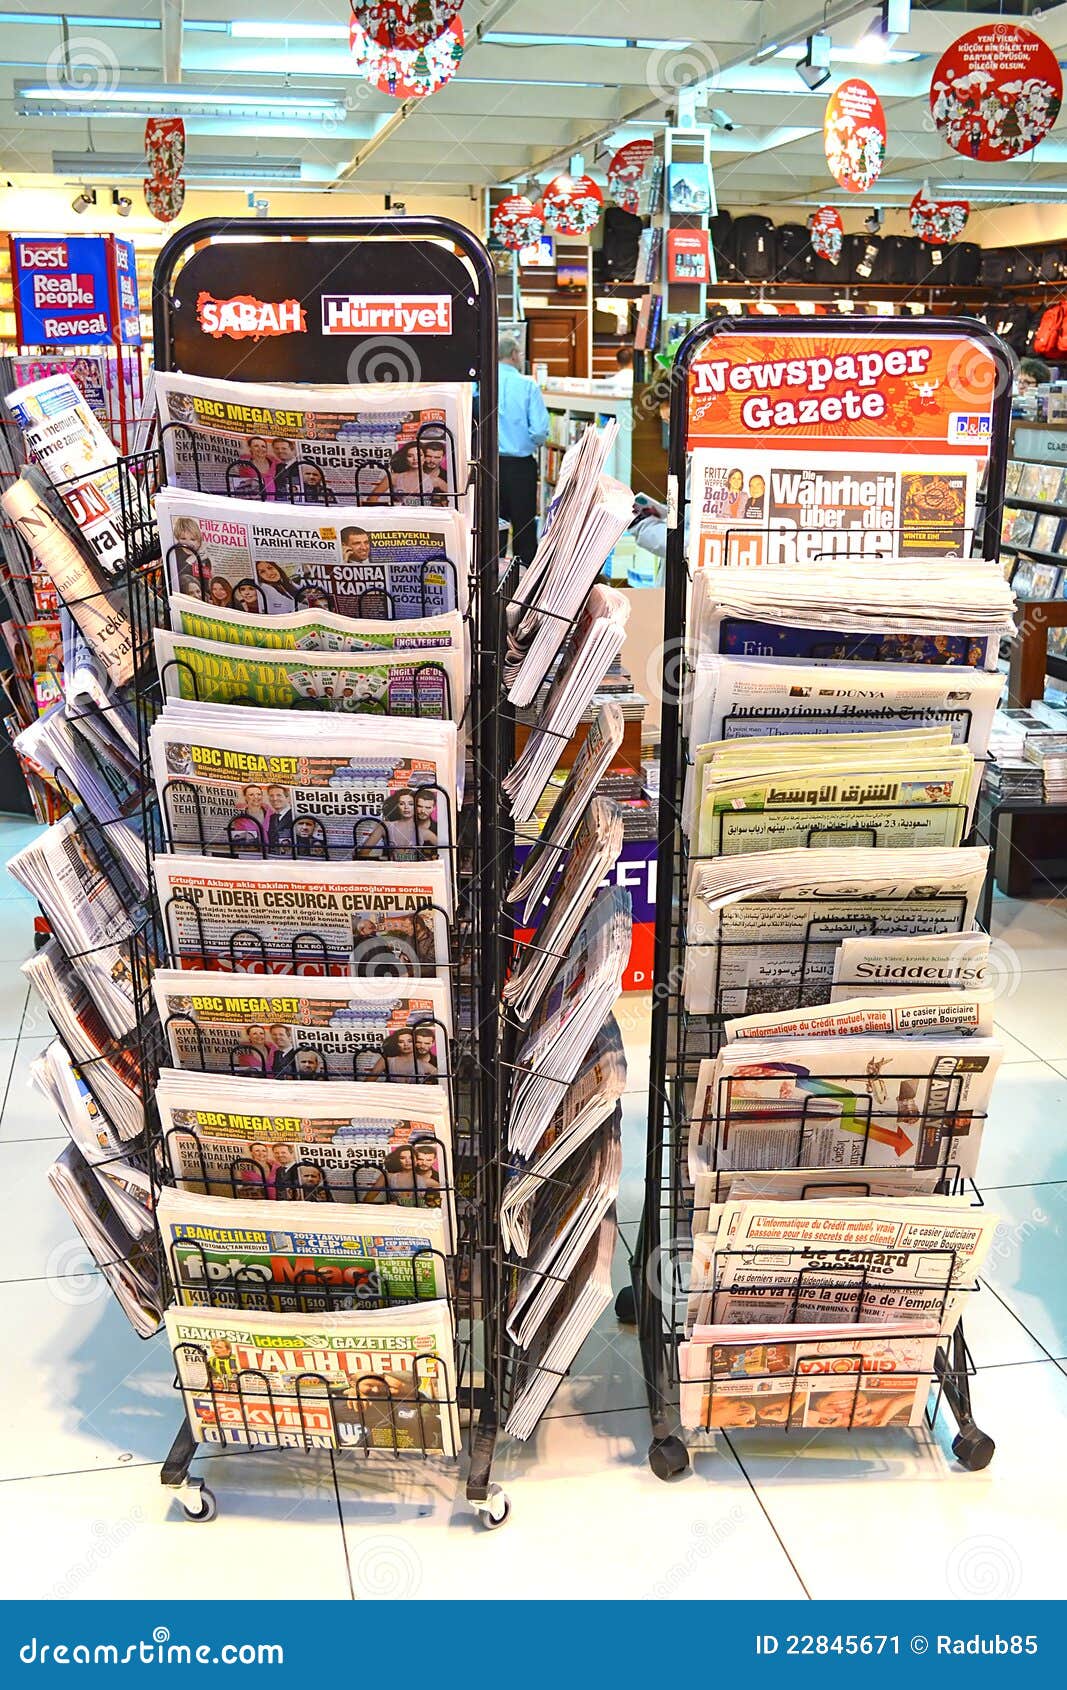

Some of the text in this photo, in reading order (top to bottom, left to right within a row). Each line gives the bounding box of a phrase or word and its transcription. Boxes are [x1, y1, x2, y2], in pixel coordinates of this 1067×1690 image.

[20, 244, 68, 267] best
[33, 274, 78, 292] Real
[35, 289, 94, 308] people
[202, 301, 301, 331] SABAH
[328, 301, 449, 333] Hürriyet
[45, 314, 108, 338] Reveal
[692, 347, 929, 395] Newspaper
[193, 397, 226, 418] BBC
[227, 403, 274, 424] MEGA
[275, 411, 304, 427] SET
[743, 389, 885, 428] Gazete
[957, 417, 991, 435] D&R
[301, 443, 346, 457] Belalı
[704, 467, 728, 479] FRITZ
[704, 487, 738, 504] Baby
[771, 473, 895, 506] Wahrheit
[703, 501, 723, 514] da!
[800, 504, 845, 528] über
[862, 505, 893, 529] die
[200, 520, 246, 535] Filiz Abla
[252, 538, 336, 550] TARİHİ REKOR
[769, 517, 893, 564] Rente
[309, 566, 384, 581] YIL SONRA
[743, 641, 774, 656] Ein
[730, 702, 837, 717] International
[192, 747, 221, 766] BBC
[223, 751, 268, 772] MEGA
[270, 757, 298, 774] SET
[295, 791, 385, 804] Belalı âşığa
[841, 784, 898, 805] الشرق
[171, 877, 205, 885] Ertuğrul
[207, 880, 234, 889] Akbay
[258, 882, 289, 890] takılan
[173, 886, 204, 903] CHP
[264, 892, 338, 910] CESURCA
[342, 894, 432, 911] CEVAPLADI
[192, 997, 223, 1011] BBC
[224, 998, 270, 1013] MEGA
[271, 998, 300, 1013] SET
[901, 1005, 974, 1017] Le casier judiciaire
[799, 1021, 810, 1030] du
[811, 1018, 835, 1028] Crédit
[867, 1012, 887, 1020] vraie
[838, 1026, 849, 1034] de
[865, 1022, 891, 1031] clients
[899, 1014, 976, 1028] du groupe Bouygues
[297, 1030, 339, 1041] Belalı
[196, 1112, 227, 1127] BBC
[229, 1113, 273, 1131] MEGA
[274, 1117, 301, 1132] SET
[300, 1146, 342, 1158] Belalı
[756, 1217, 895, 1233] L'informatique du Crédit mutuel, vraie
[908, 1226, 977, 1240] Le casier judiciaire
[308, 1239, 340, 1248] CEP
[749, 1228, 895, 1245] passoire pour les secrets de ses clients
[902, 1236, 975, 1251] du groupe Bouygues
[733, 1273, 745, 1281] Les
[745, 1273, 773, 1283] derniers
[820, 1289, 832, 1300] la
[879, 1295, 895, 1306] de
